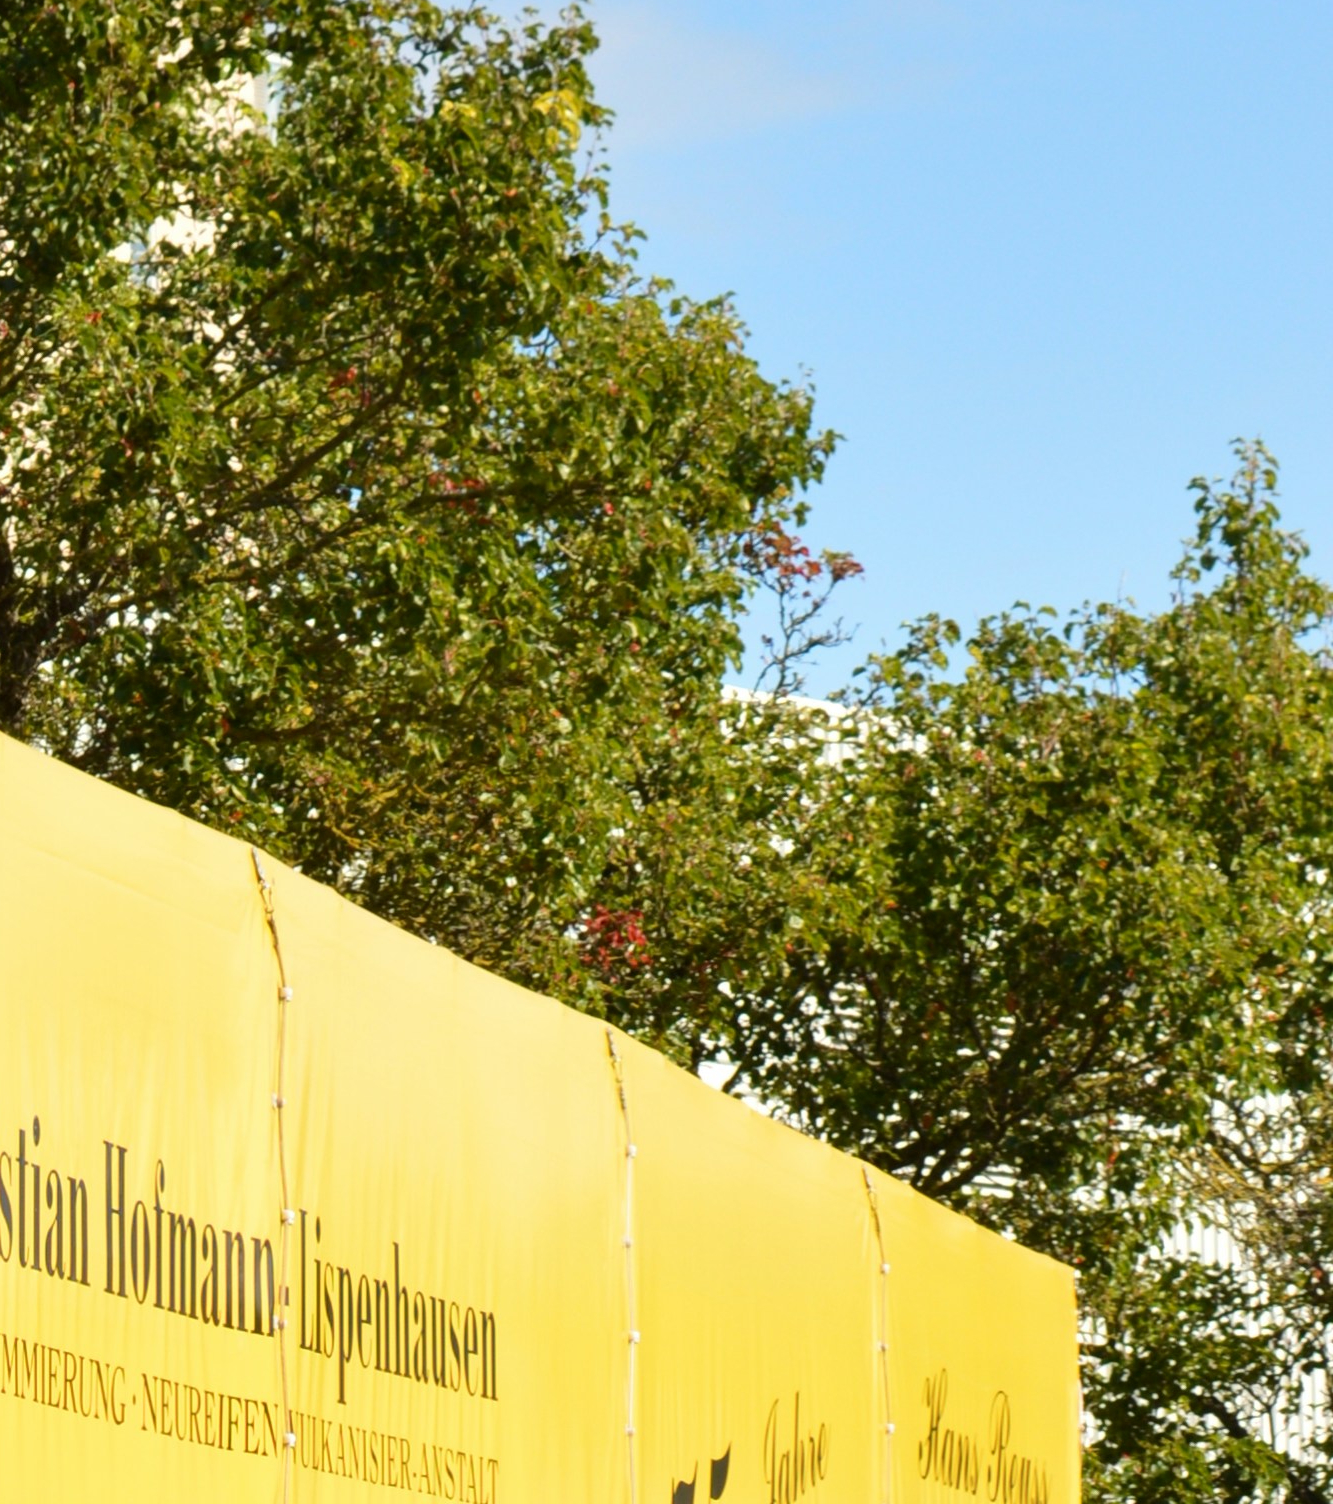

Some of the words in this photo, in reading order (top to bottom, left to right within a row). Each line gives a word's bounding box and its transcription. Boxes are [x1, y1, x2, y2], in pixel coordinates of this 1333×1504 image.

[103, 1140, 275, 1338] Hofmann
[299, 1208, 500, 1404] Lispenhausen
[141, 1373, 279, 1458] NEUREIFEN
[918, 1368, 979, 1496] Hans
